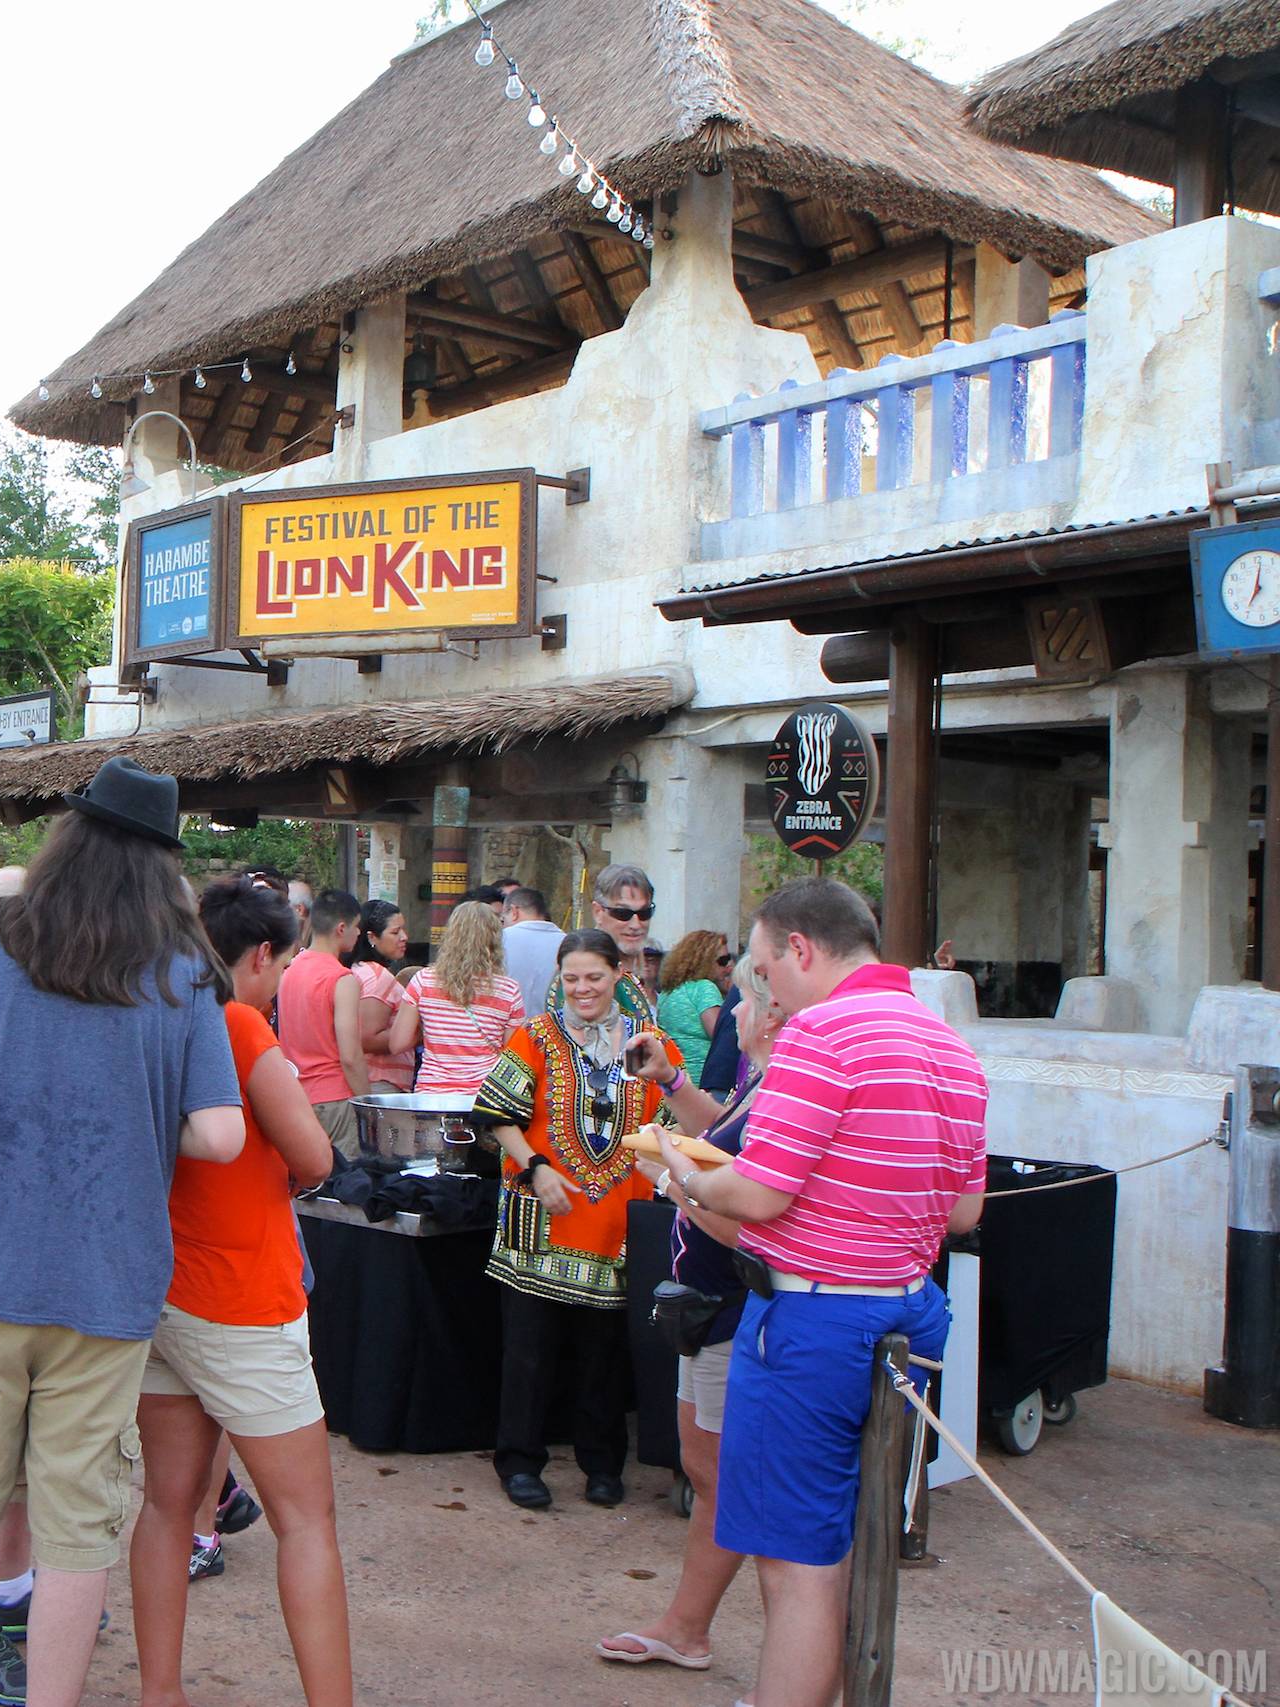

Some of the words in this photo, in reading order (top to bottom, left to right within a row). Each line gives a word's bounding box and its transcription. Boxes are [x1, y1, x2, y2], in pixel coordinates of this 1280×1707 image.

[265, 509, 392, 545] FESTIVAL
[404, 505, 437, 534] OF
[447, 500, 500, 531] THE
[145, 540, 210, 578] HARAMBE
[145, 568, 209, 608] THEATRE
[13, 706, 49, 728] ENTRANCE
[795, 800, 832, 815] ZEBRA
[784, 815, 843, 831] ENTRANCE
